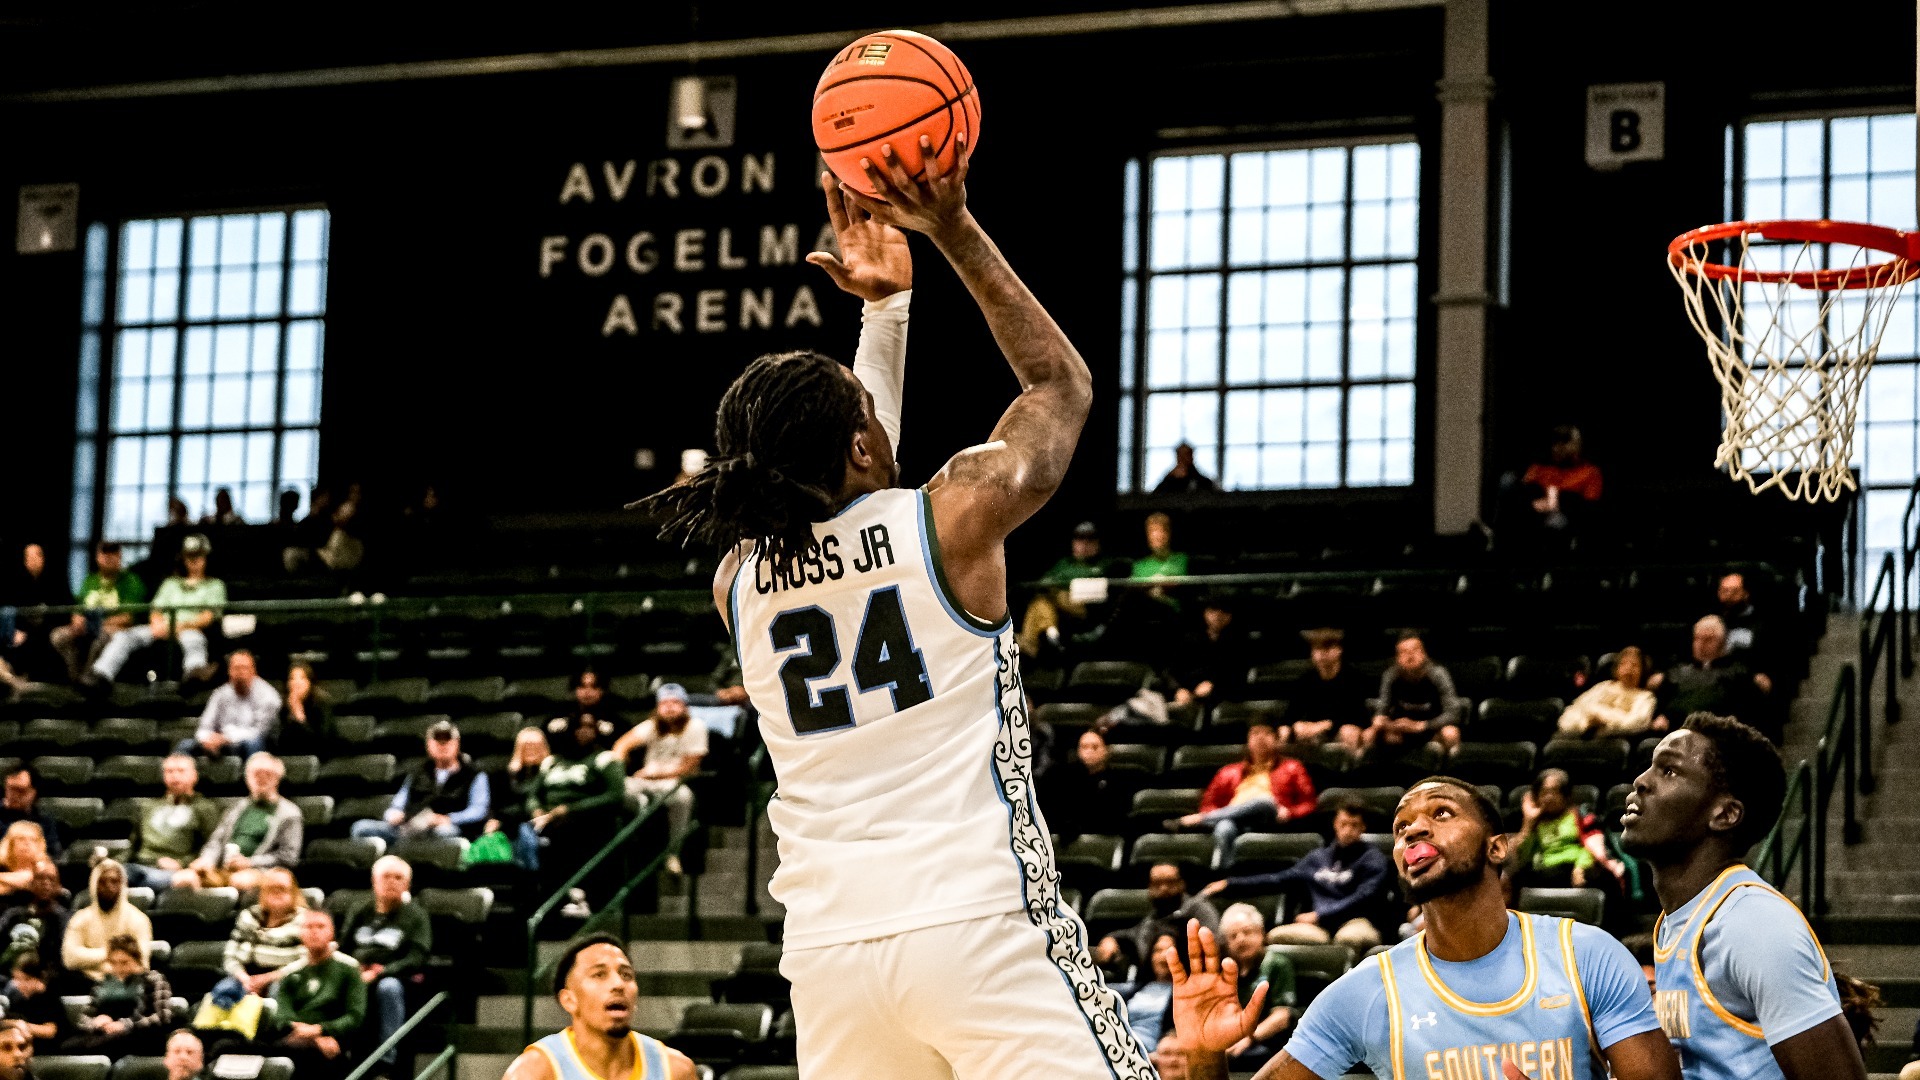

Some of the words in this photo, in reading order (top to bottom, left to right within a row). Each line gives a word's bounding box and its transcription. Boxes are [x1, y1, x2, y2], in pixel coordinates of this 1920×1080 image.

[1610, 108, 1641, 153] B
[559, 152, 775, 204] AVRON
[538, 222, 843, 278] FOGELMA
[601, 284, 822, 336] ARENA
[853, 523, 895, 574] JR
[768, 584, 934, 737] 24
